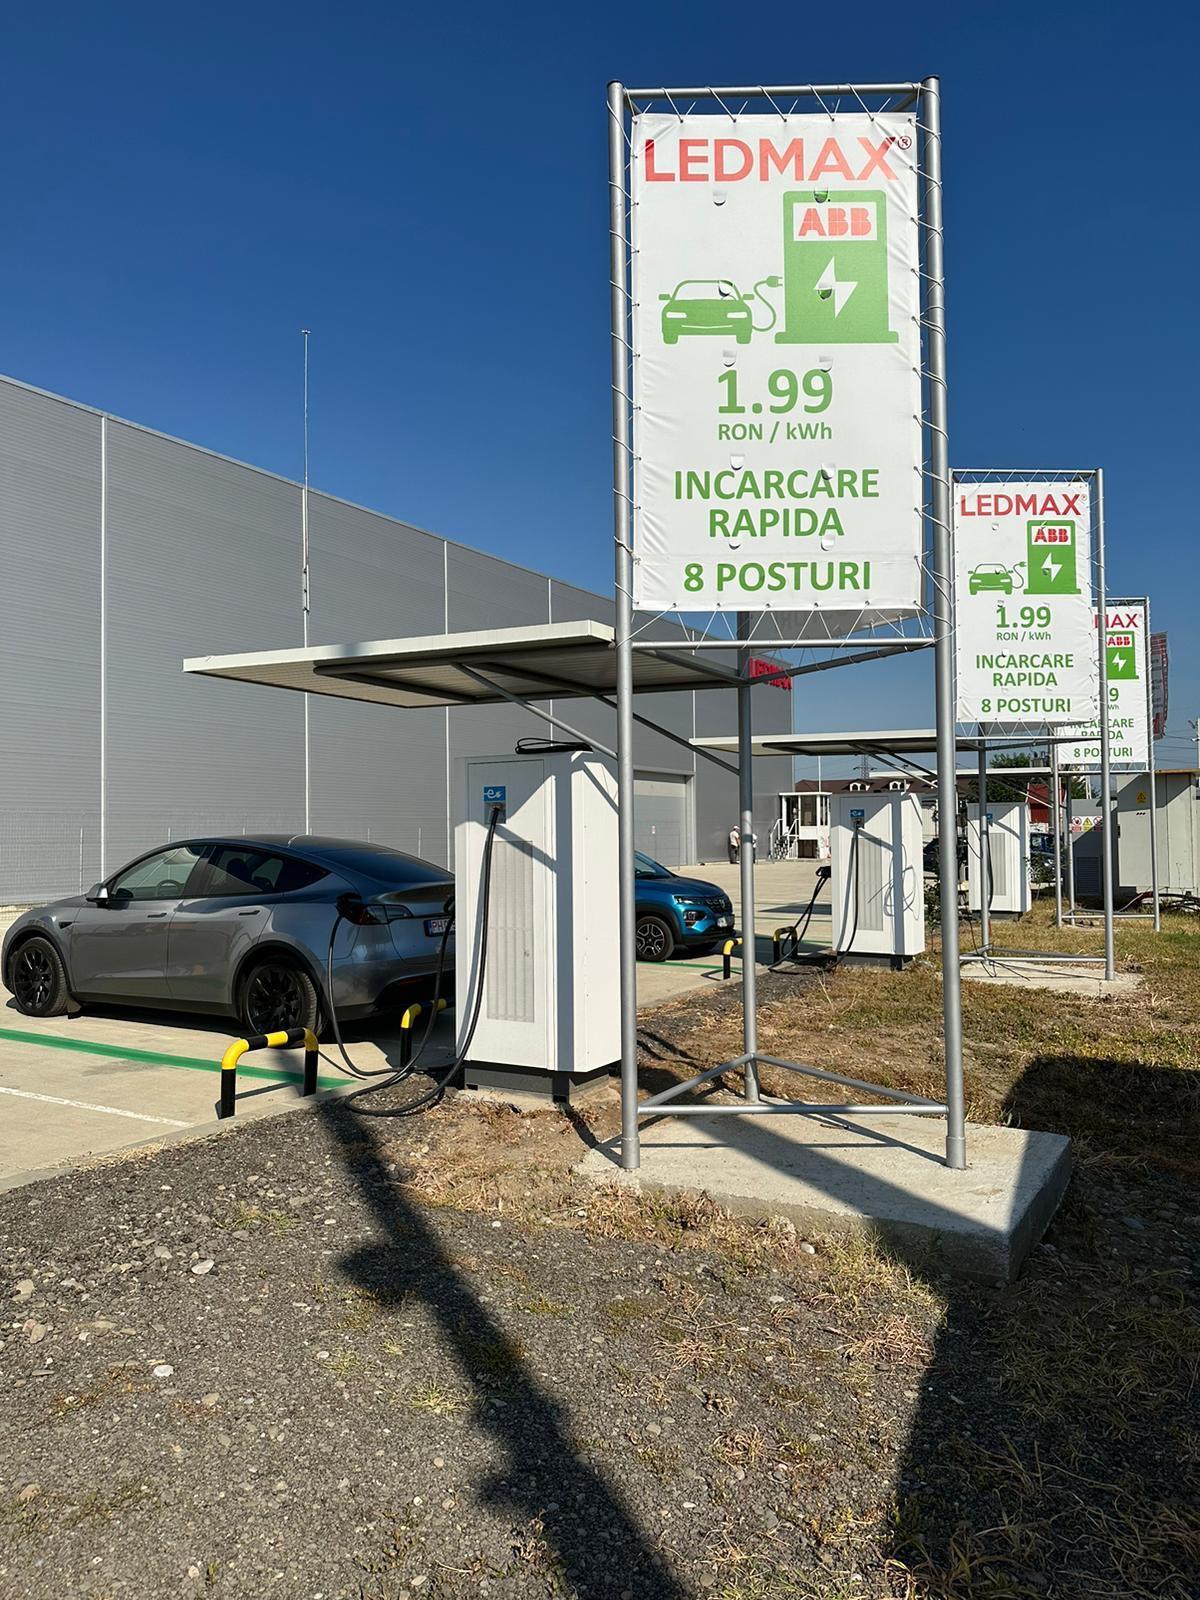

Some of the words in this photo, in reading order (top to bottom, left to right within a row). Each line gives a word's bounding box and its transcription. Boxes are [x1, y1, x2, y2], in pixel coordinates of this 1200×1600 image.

[797, 207, 872, 237] ABB
[717, 368, 833, 414] 1.99
[718, 423, 763, 441] RON
[786, 422, 832, 440] kWh
[674, 469, 880, 500] INCARCARE
[708, 507, 845, 538] RAPIDA
[1034, 529, 1069, 543] ABB
[683, 562, 704, 592] 8
[716, 561, 870, 592] POSTURI
[996, 606, 1052, 629] 1.99
[996, 632, 1019, 641] RON
[1028, 631, 1052, 641] kWh
[1107, 636, 1131, 646] ABB
[976, 654, 1074, 669] INCARCARE
[992, 672, 1058, 687] RAPIDA
[981, 699, 992, 713] 8
[997, 698, 1071, 713] POSTURI
[1073, 747, 1081, 758] 8
[1084, 747, 1133, 758] POTURI
